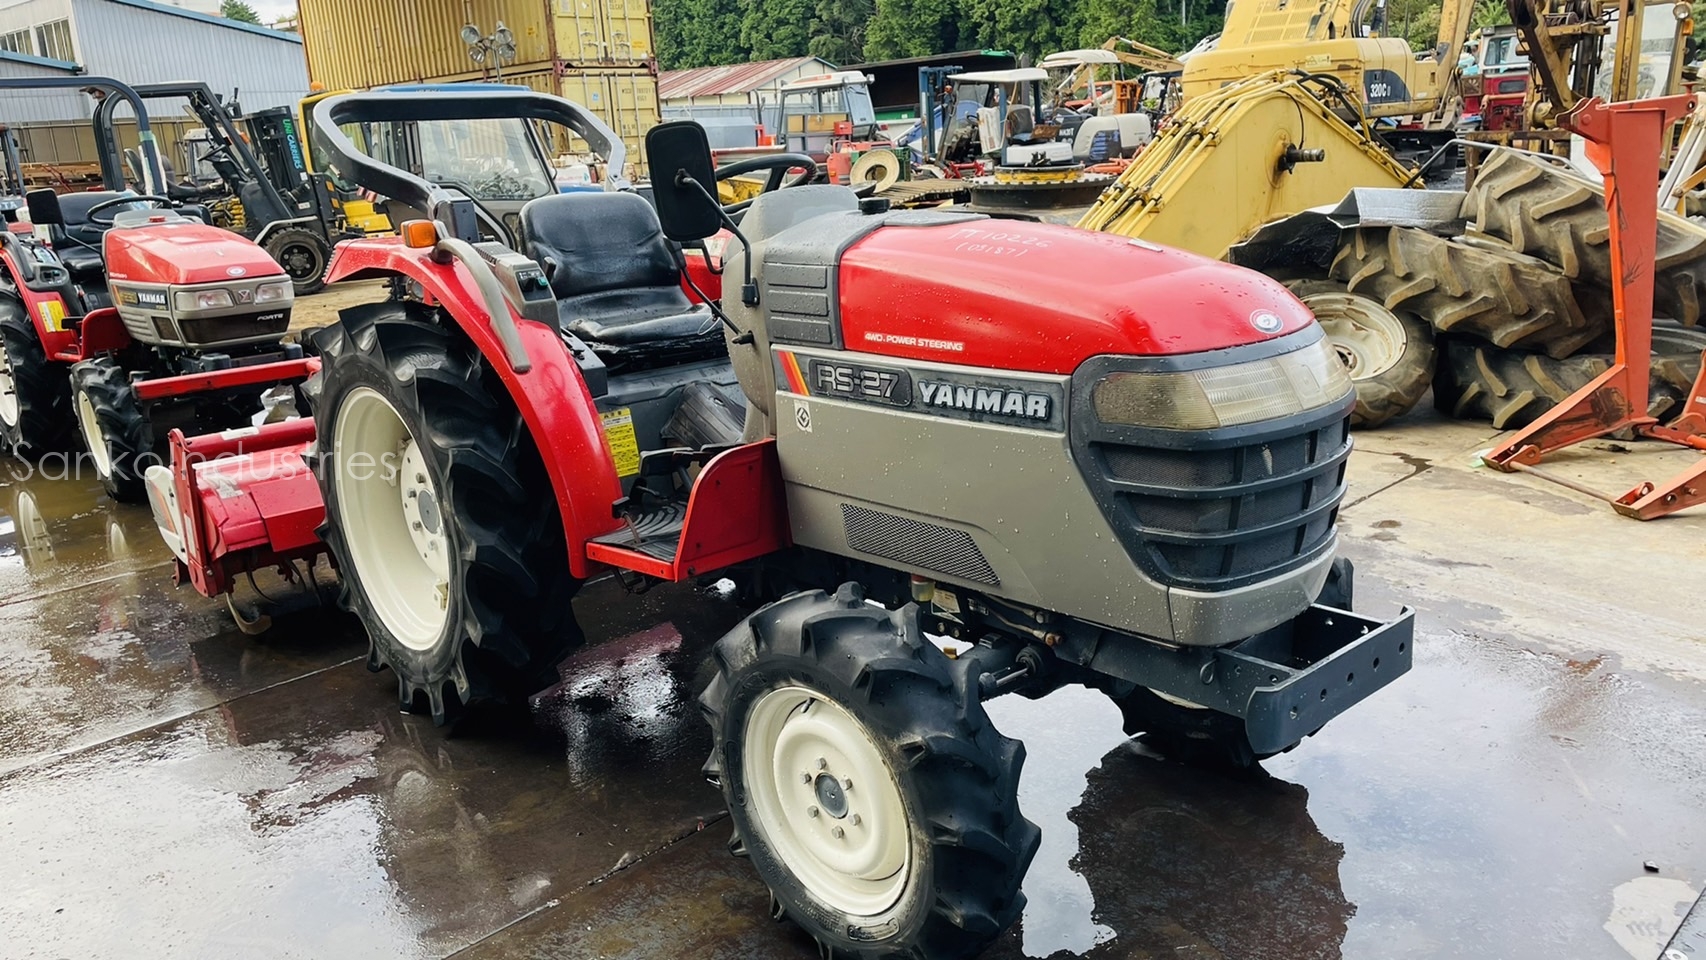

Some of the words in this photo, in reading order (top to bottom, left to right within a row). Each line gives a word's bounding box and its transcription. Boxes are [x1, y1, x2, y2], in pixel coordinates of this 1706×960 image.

[1370, 83, 1387, 98] 320C
[138, 292, 166, 304] YANMAR
[256, 313, 284, 321] FORTE
[886, 334, 917, 346] POWER
[918, 338, 964, 351] STEERING
[817, 364, 899, 398] RS-27
[918, 379, 1049, 419] YANMAR
